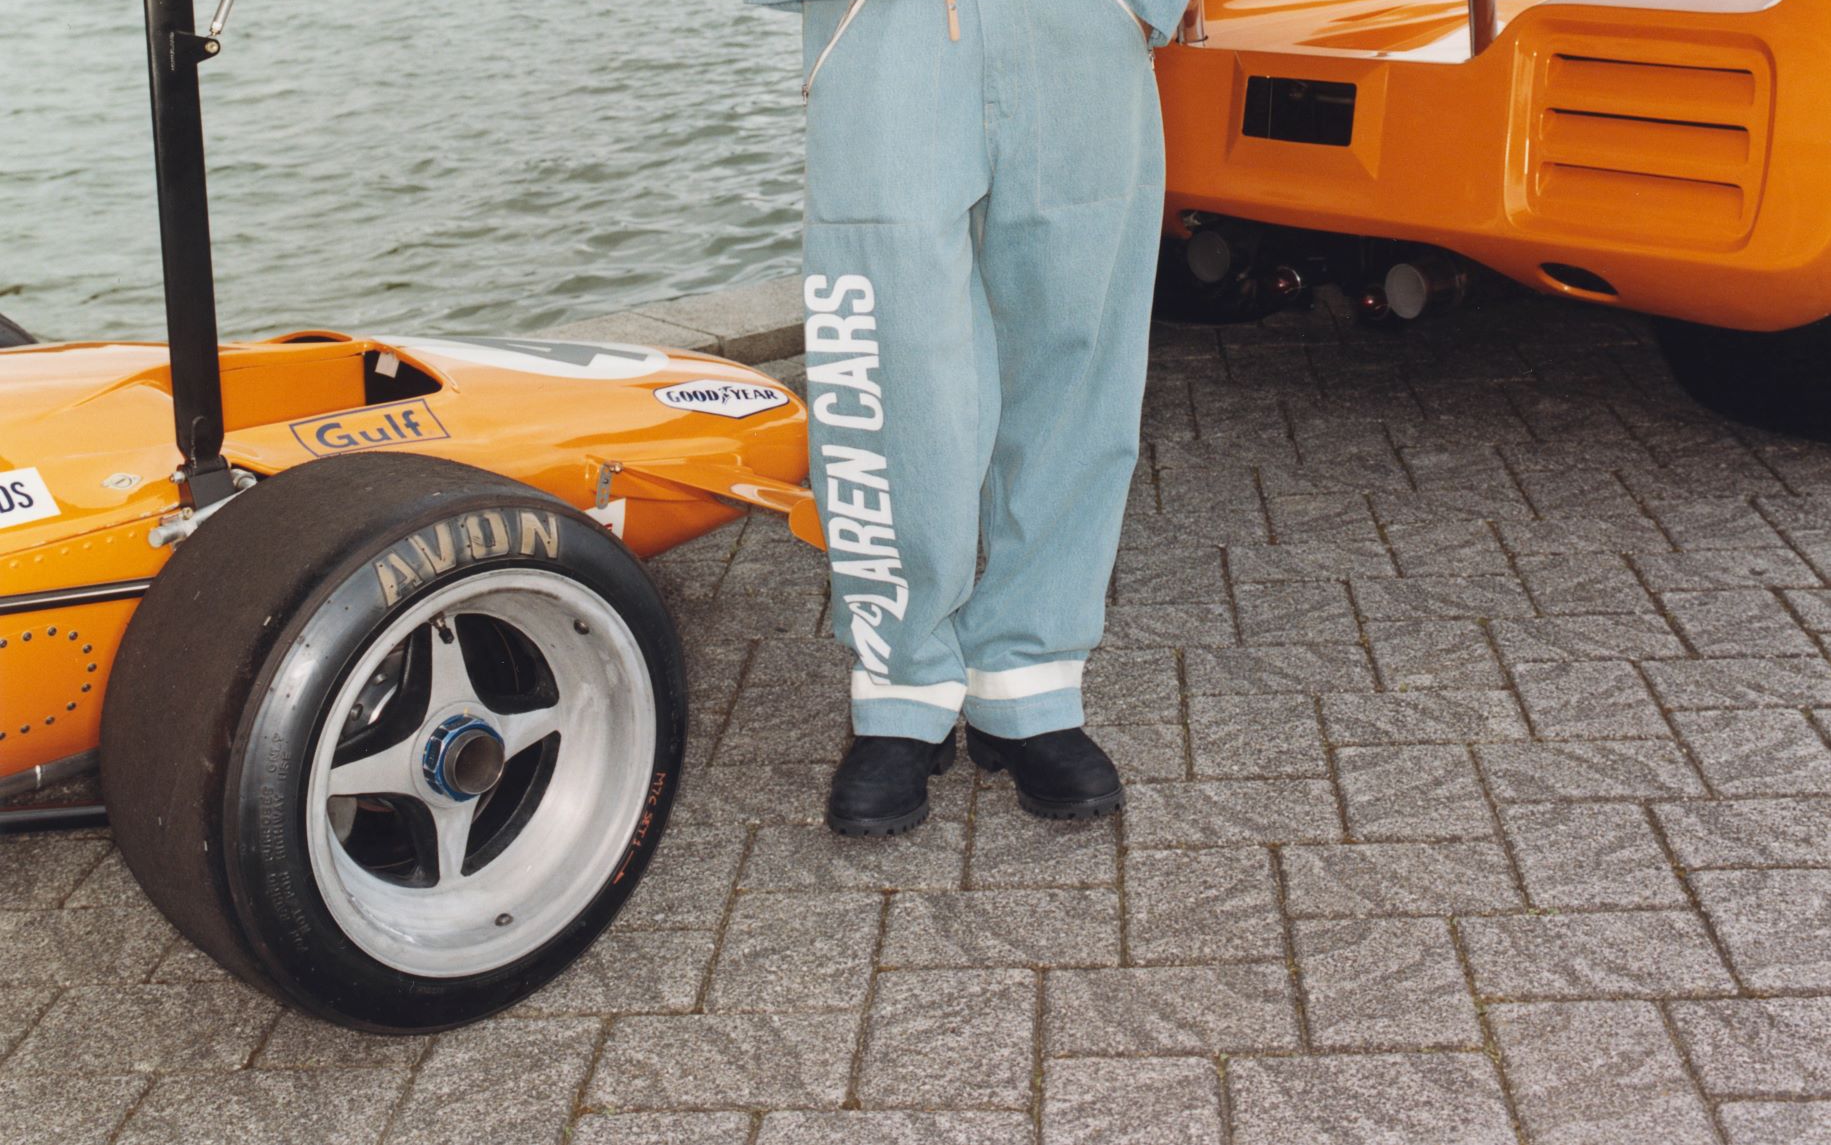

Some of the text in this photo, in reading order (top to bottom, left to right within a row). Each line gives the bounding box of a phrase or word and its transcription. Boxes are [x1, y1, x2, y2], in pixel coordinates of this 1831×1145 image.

[804, 273, 884, 432] CARS
[315, 410, 423, 449] Gulf
[373, 507, 559, 606] AVON
